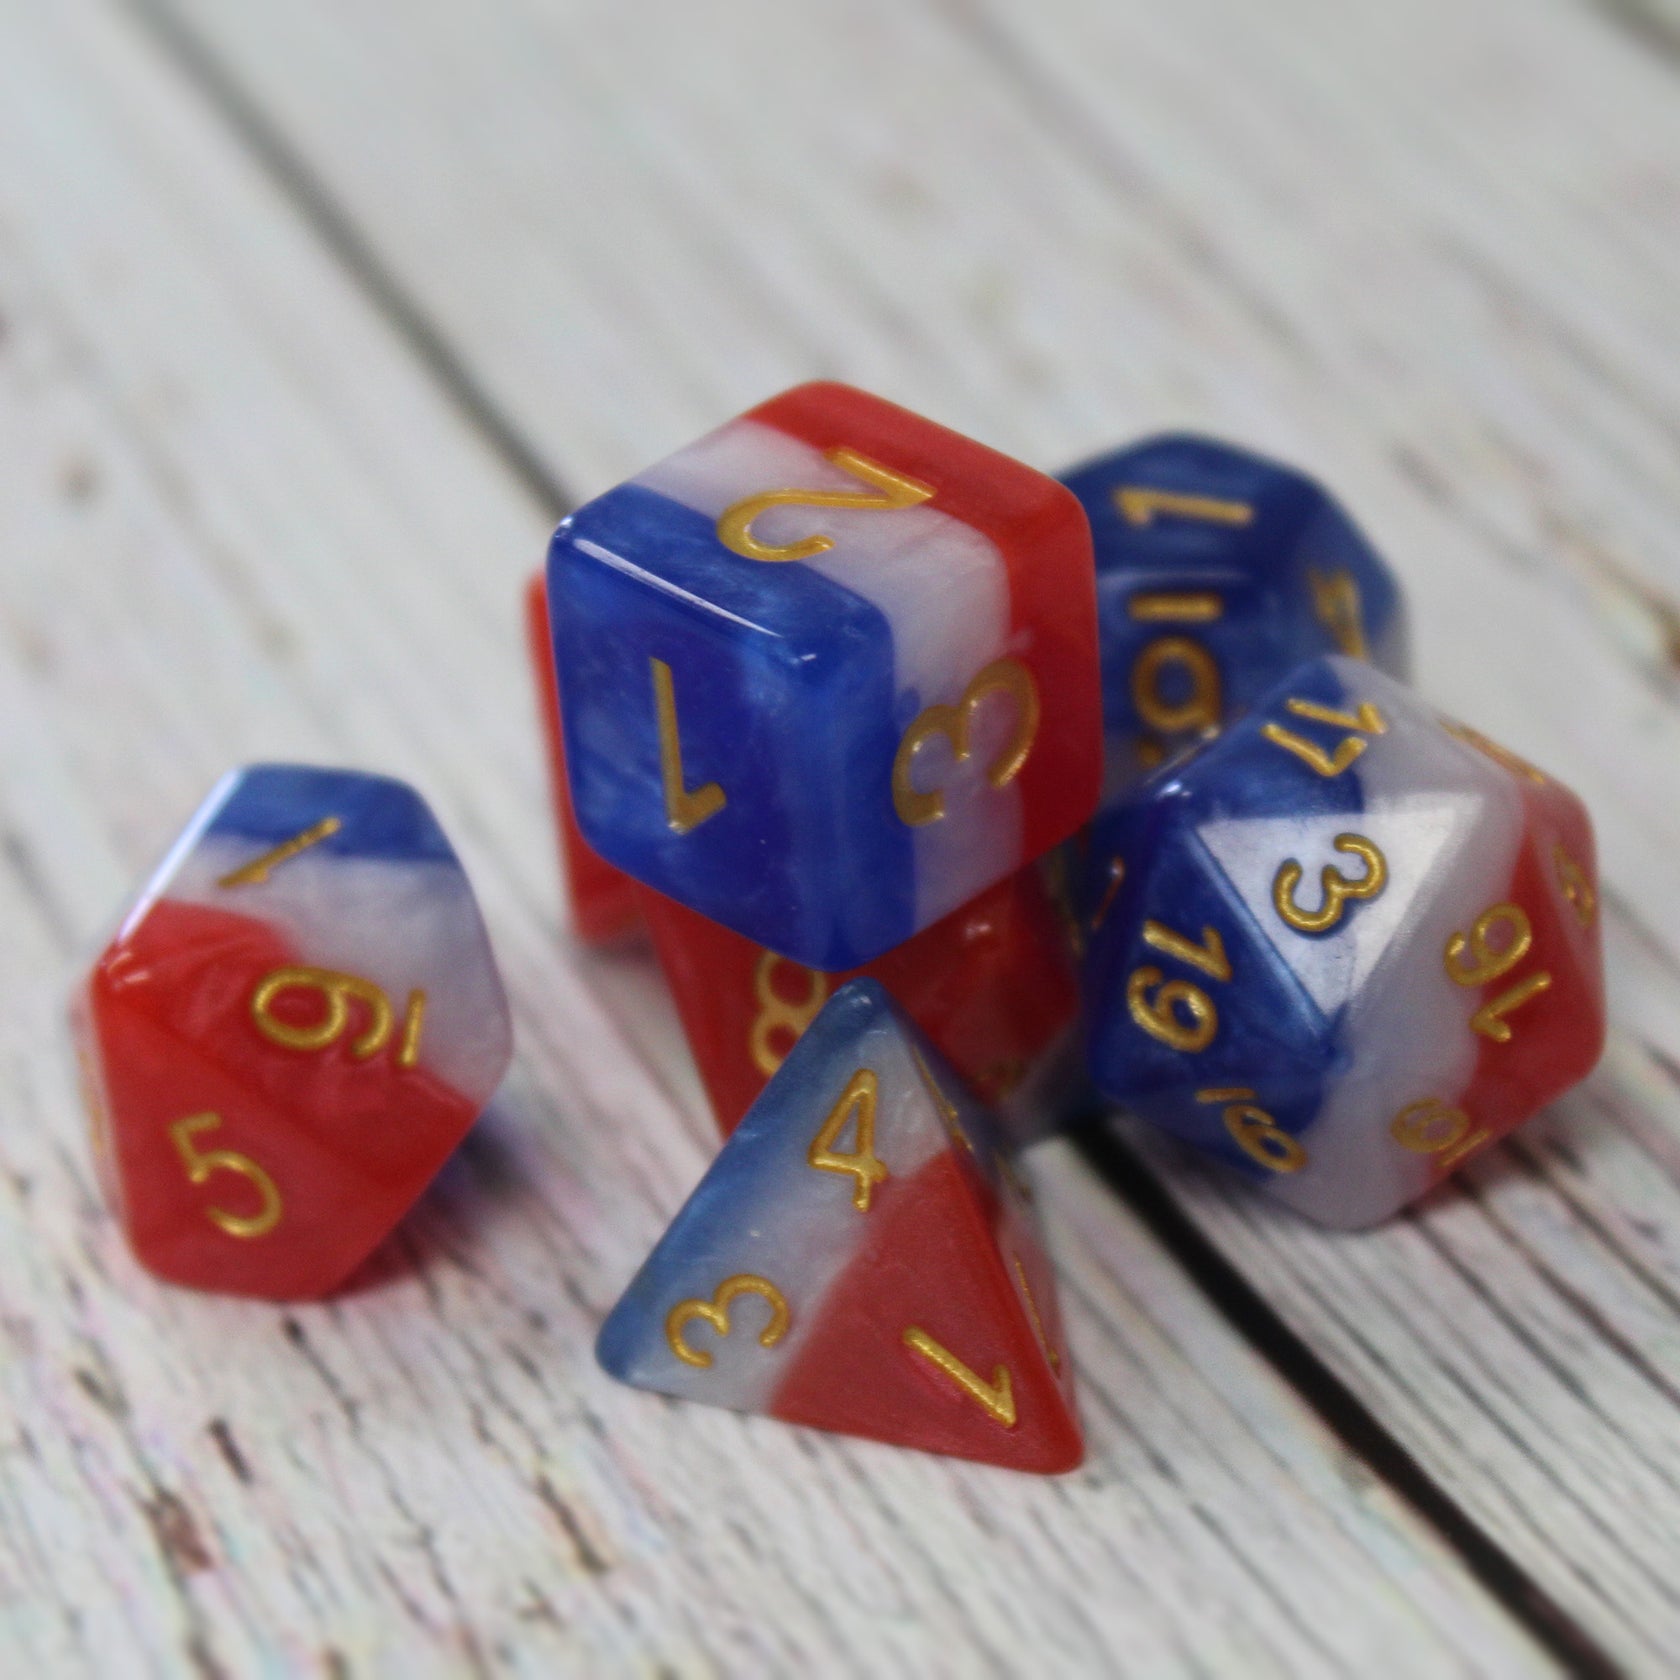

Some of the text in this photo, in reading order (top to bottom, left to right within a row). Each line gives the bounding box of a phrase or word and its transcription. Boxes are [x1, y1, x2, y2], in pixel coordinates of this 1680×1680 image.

[717, 447, 936, 562] 2
[1113, 487, 1253, 526] 1
[649, 656, 727, 835] 1
[892, 658, 1039, 827] 3
[1262, 697, 1387, 778] 17
[1271, 831, 1387, 933] 3
[1126, 918, 1232, 1053] 19
[1443, 902, 1551, 1043] 16
[167, 1112, 283, 1238] 5
[808, 1068, 888, 1213] 4
[664, 1273, 791, 1368] 3
[904, 1325, 1016, 1448] 1
